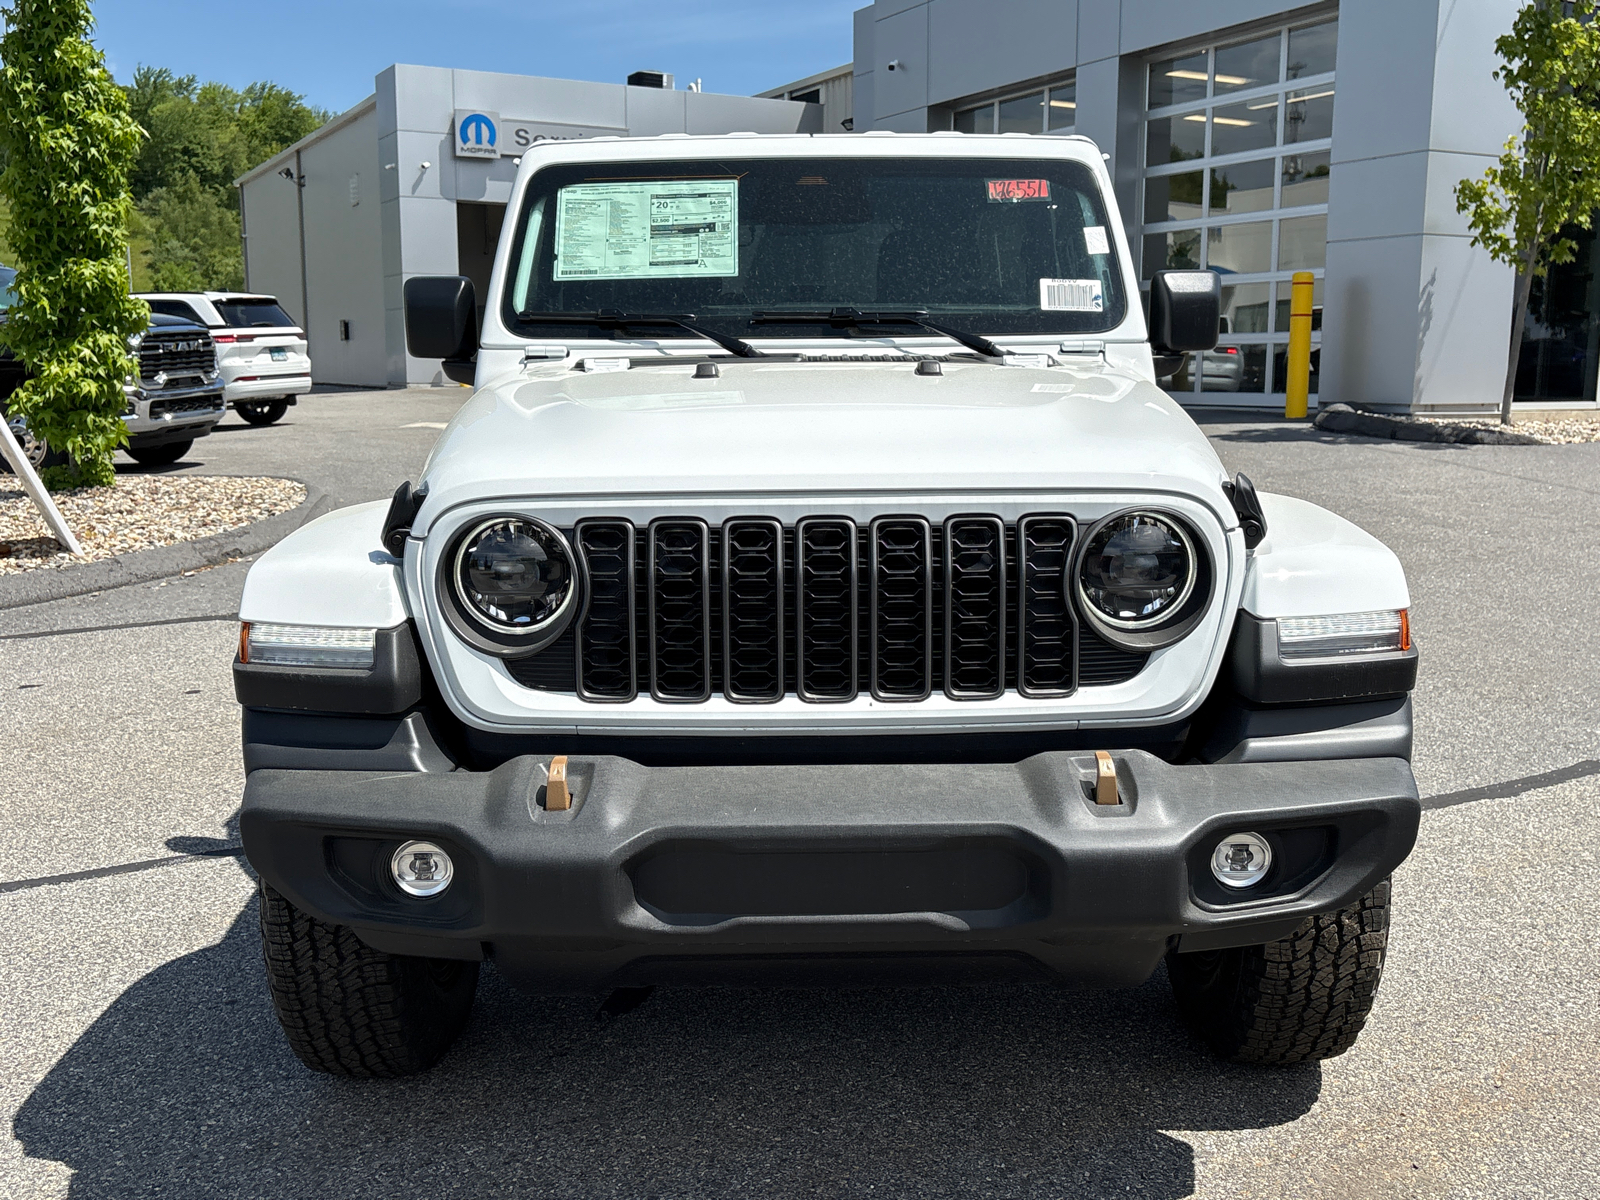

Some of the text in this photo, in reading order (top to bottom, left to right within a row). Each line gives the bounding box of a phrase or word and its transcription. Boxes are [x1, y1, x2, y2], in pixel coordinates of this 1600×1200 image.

[460, 146, 497, 155] MOPAR
[656, 201, 669, 209] 20
[162, 341, 204, 352] RAM
